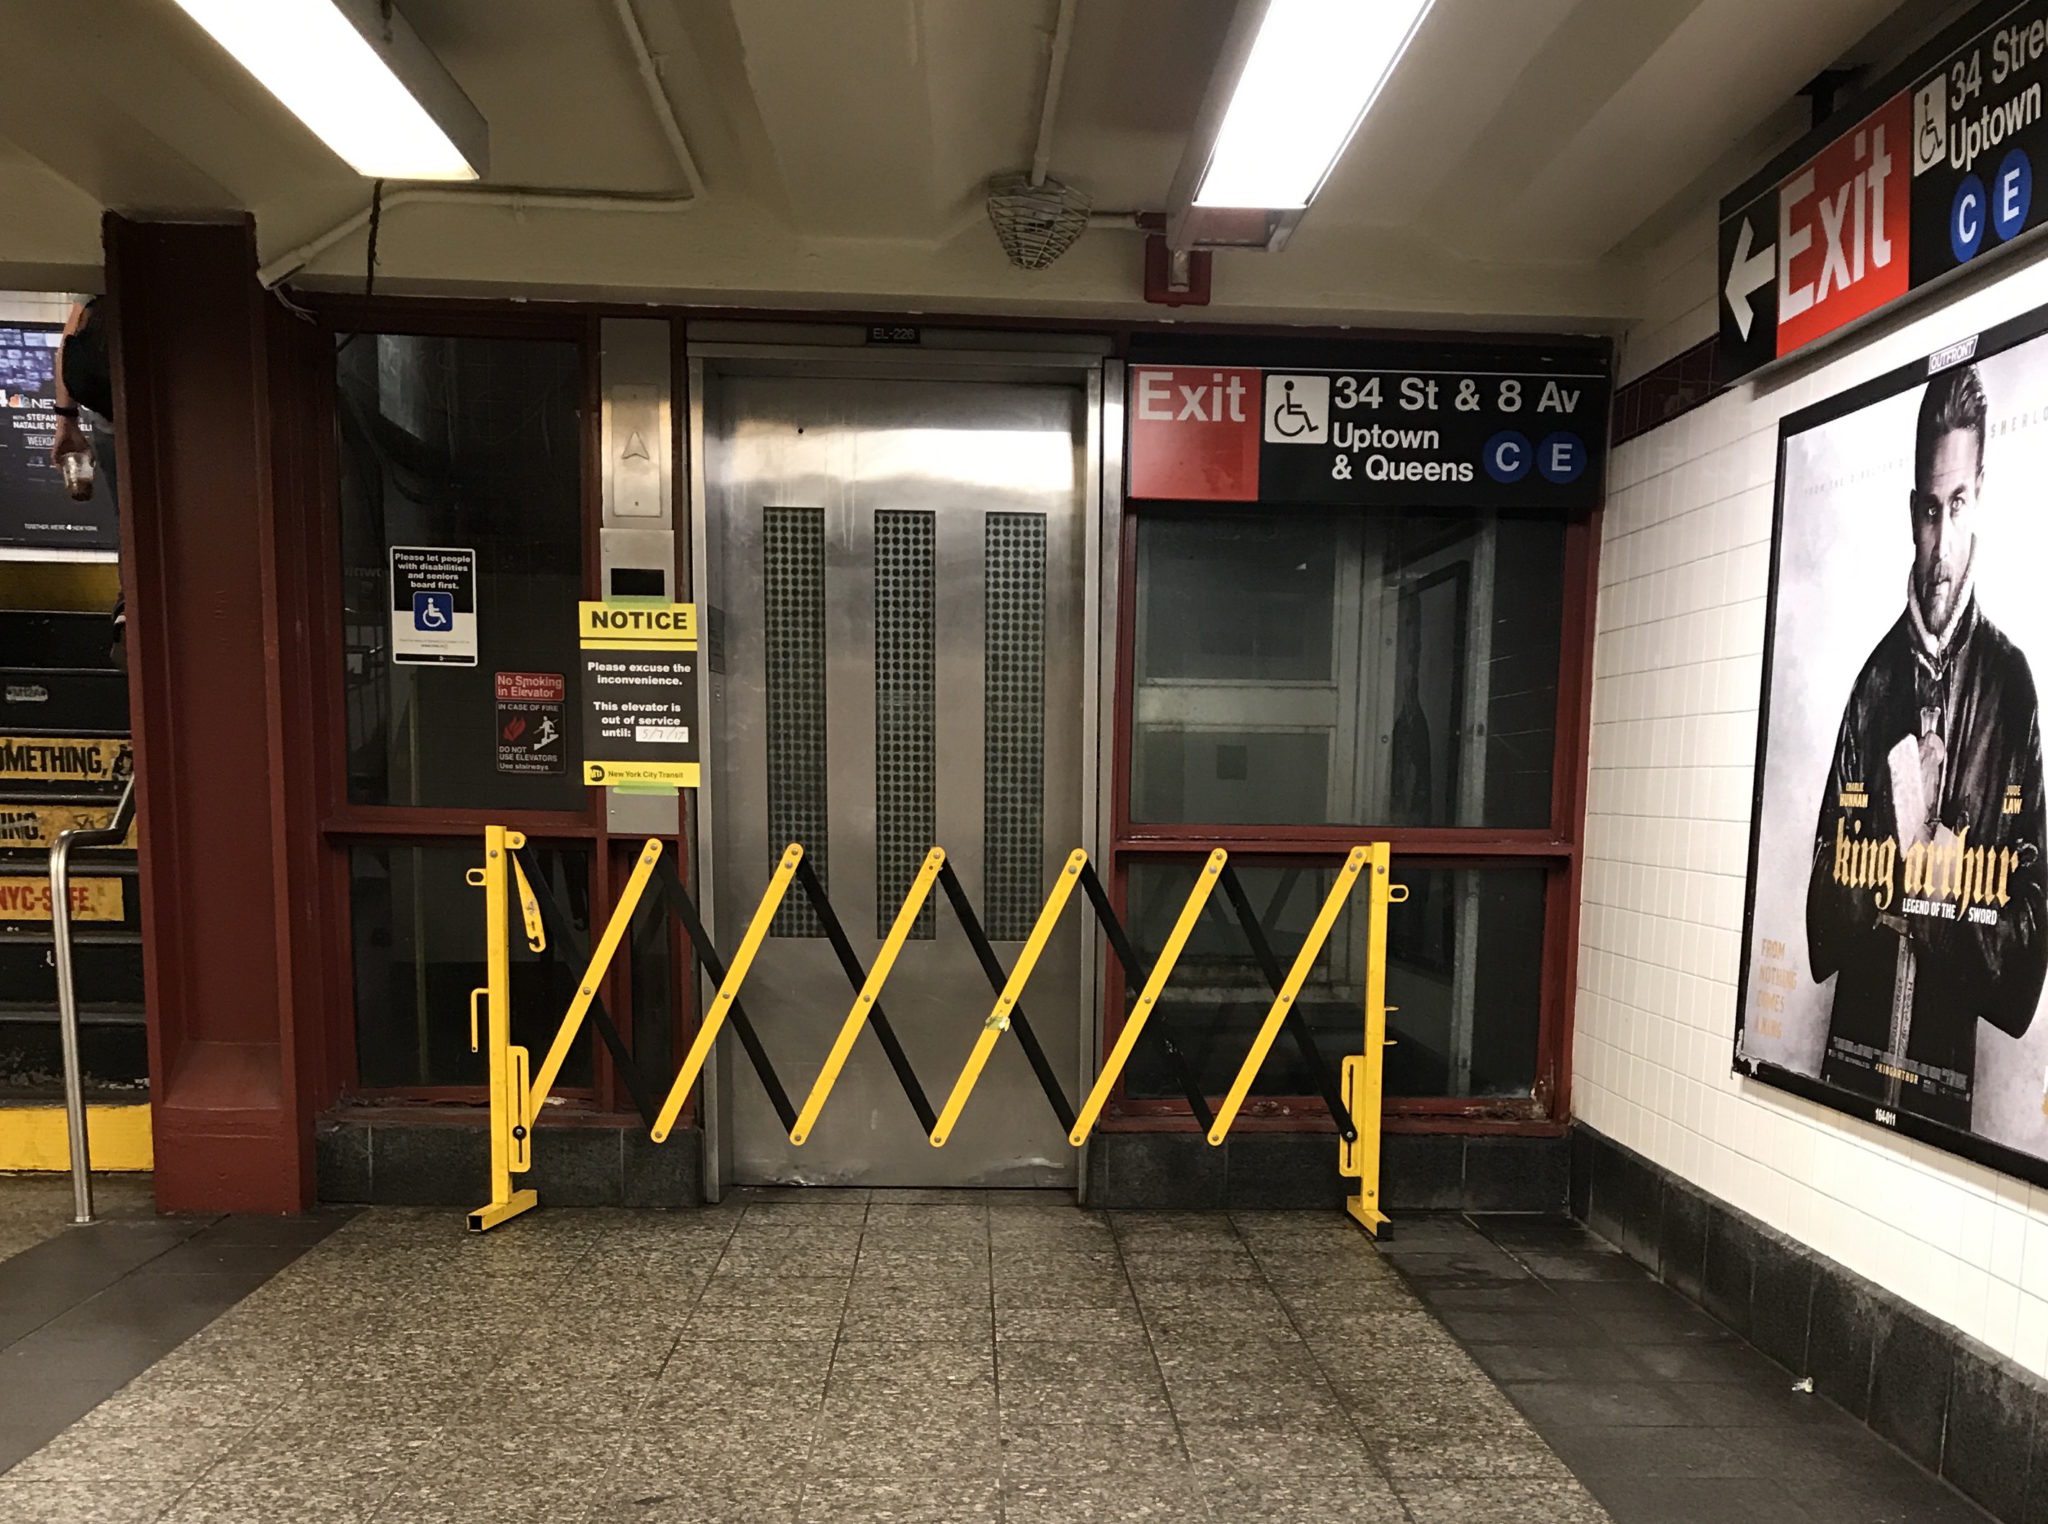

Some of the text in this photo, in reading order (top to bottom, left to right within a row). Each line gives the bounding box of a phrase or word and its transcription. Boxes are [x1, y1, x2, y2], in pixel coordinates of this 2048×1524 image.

[1951, 19, 2048, 111] 34 Stre
[1951, 82, 2041, 172] Uptown
[2003, 168, 2020, 223] E
[1777, 123, 1892, 326] Exit
[1958, 193, 1977, 244] C
[1931, 337, 1976, 370] OUTFRONT
[1138, 371, 1247, 422] Exit
[1334, 376, 1580, 413] 34 St & 8 Av
[13, 421, 44, 430] NATALIE
[1333, 422, 1440, 453] Uptown
[1496, 442, 1573, 472] C E
[1331, 454, 1474, 481] & Queens
[395, 552, 424, 560] Please
[441, 554, 470, 563] people
[420, 563, 468, 571] disabilities
[438, 581, 459, 589] first.
[592, 610, 688, 630] NOTICE
[588, 661, 692, 673] Please excuse the
[498, 675, 562, 690] No Smoking
[597, 674, 683, 685] inconvenience.
[498, 686, 554, 698] in Elevator
[542, 704, 559, 712] FIRE
[593, 701, 681, 712] This elevator is
[601, 715, 681, 725] out of service
[602, 728, 631, 737] until:
[515, 763, 549, 771] stairways
[516, 754, 557, 762] ELEVATORS
[643, 771, 658, 780] City
[659, 771, 684, 779] Transit
[2002, 798, 2022, 814] LAW
[1832, 816, 2019, 922] king arthur
[0, 886, 96, 911] NYC-SFE.
[1903, 898, 1998, 925] LEGEND OF THE SWORD
[1761, 938, 1786, 960] FROM
